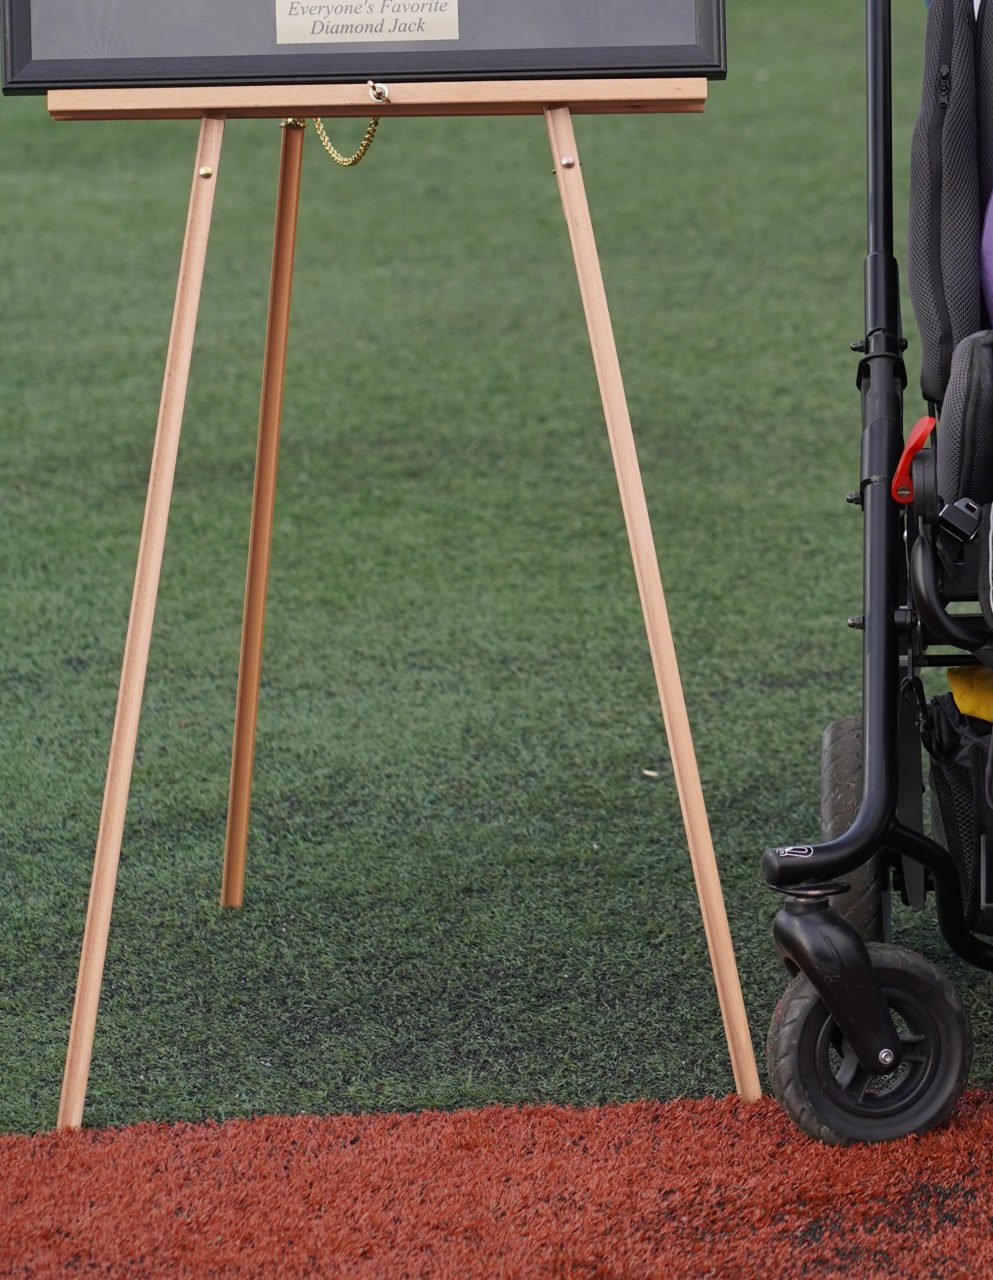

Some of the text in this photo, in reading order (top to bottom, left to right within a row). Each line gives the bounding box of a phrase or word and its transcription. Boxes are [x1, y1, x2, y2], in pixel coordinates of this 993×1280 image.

[287, 0, 375, 19] Everyone's
[310, 17, 426, 35] Diamond Jack
